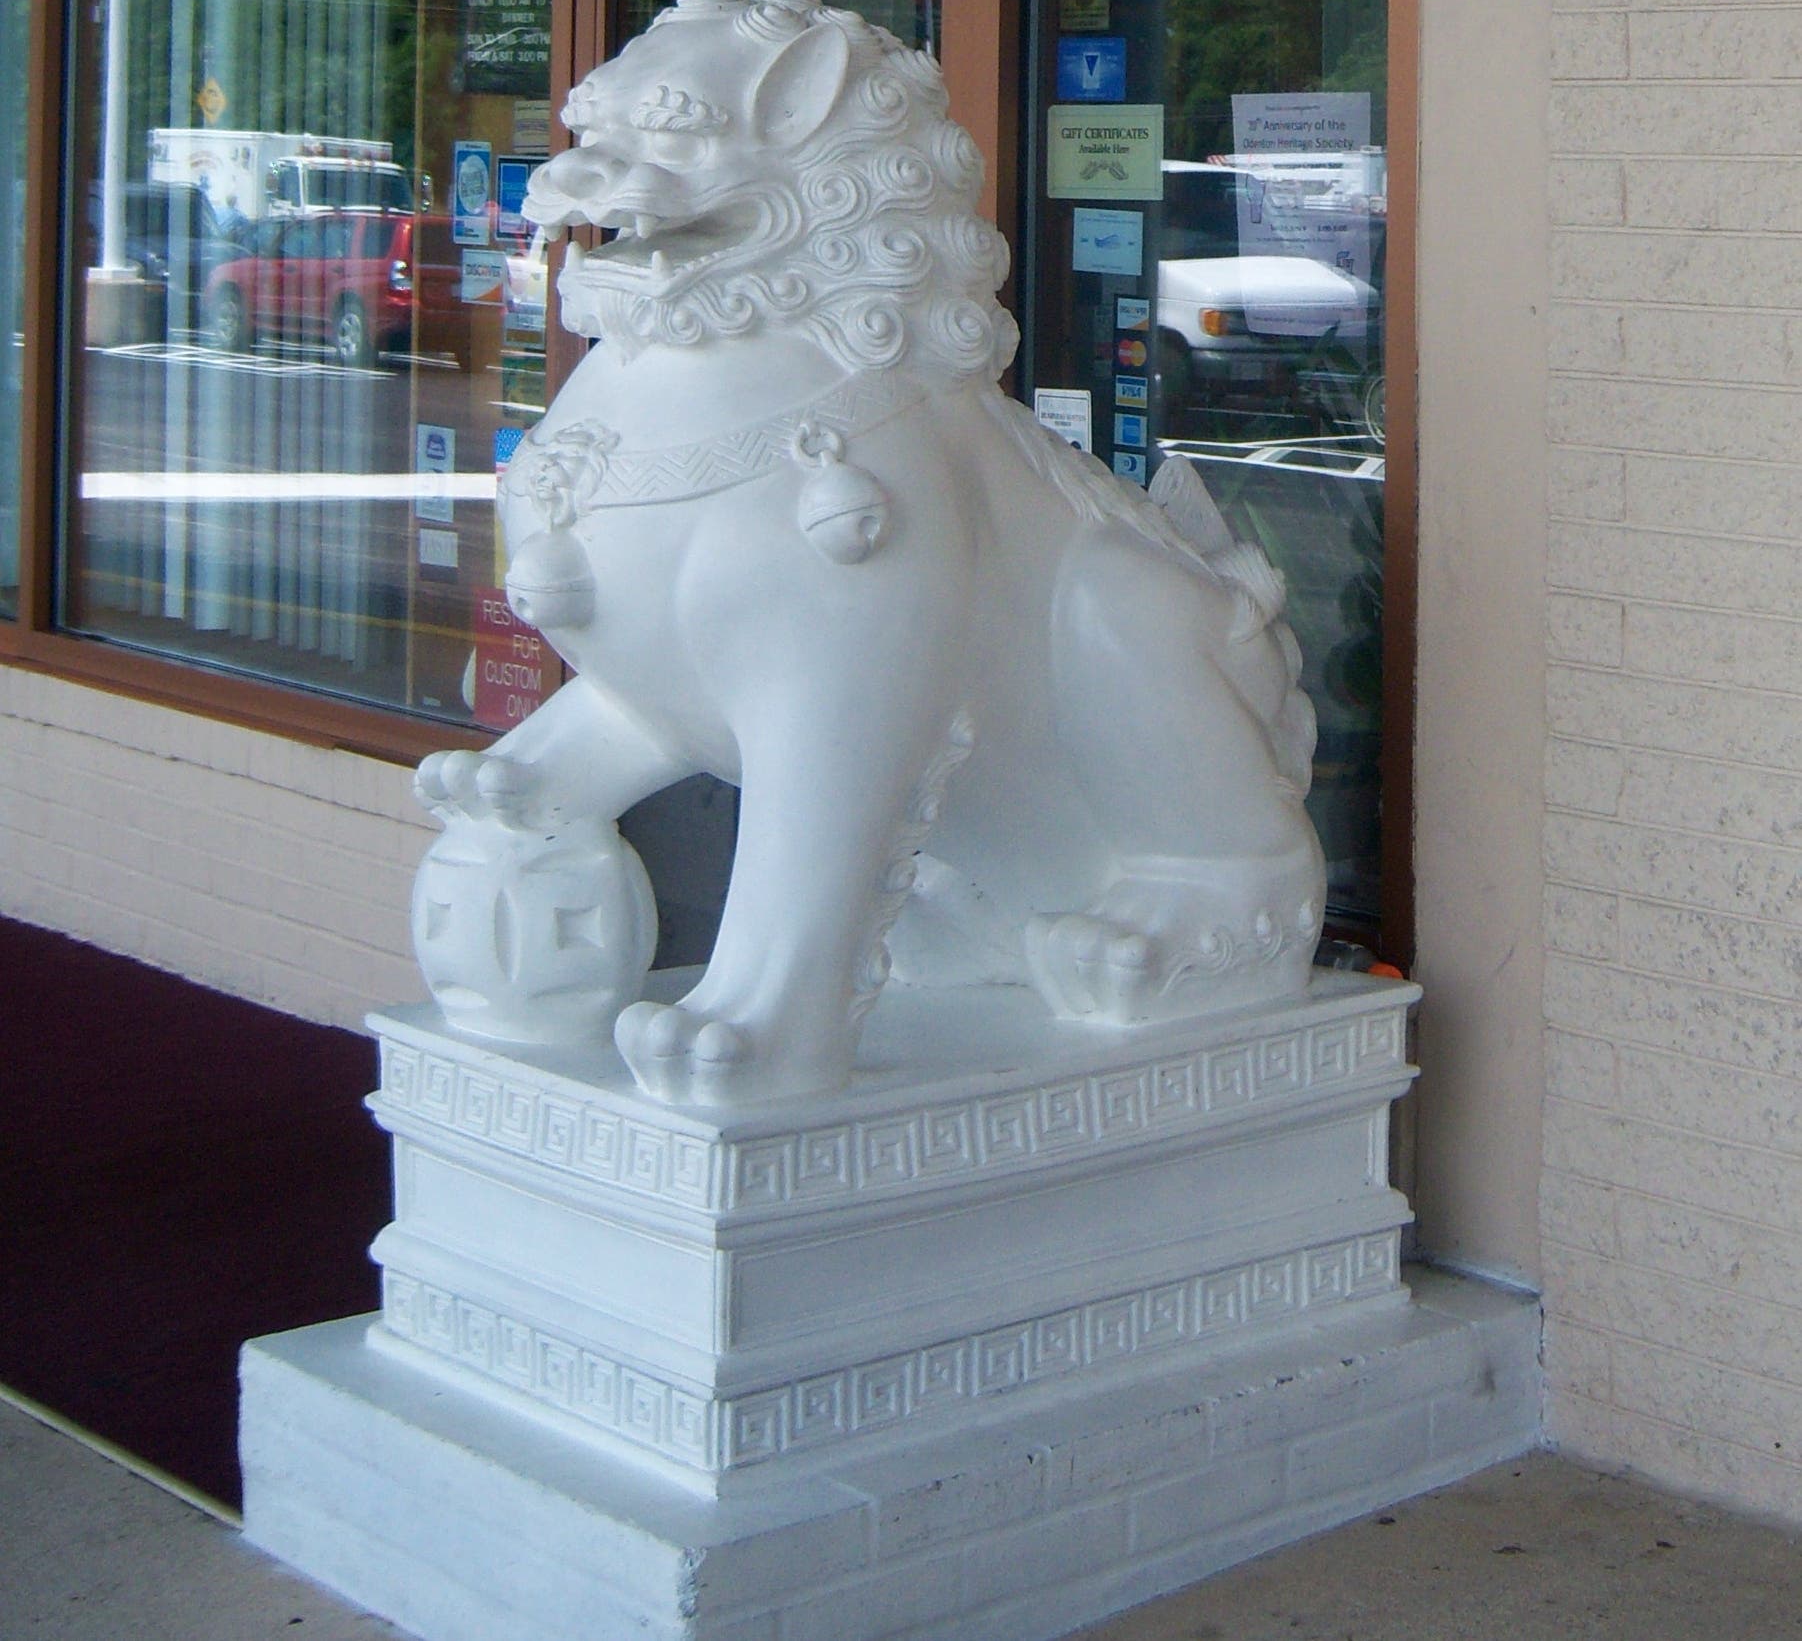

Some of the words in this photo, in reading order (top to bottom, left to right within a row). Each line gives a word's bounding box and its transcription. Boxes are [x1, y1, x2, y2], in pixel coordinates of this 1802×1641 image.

[1263, 119, 1313, 132] Anniversary
[1314, 118, 1325, 131] of
[1327, 119, 1346, 130] the
[1061, 127, 1082, 139] GIFT
[1084, 127, 1149, 140] CERTIFICATES
[1079, 143, 1110, 154] Available
[1314, 138, 1354, 151] Society
[513, 634, 541, 659] FOR
